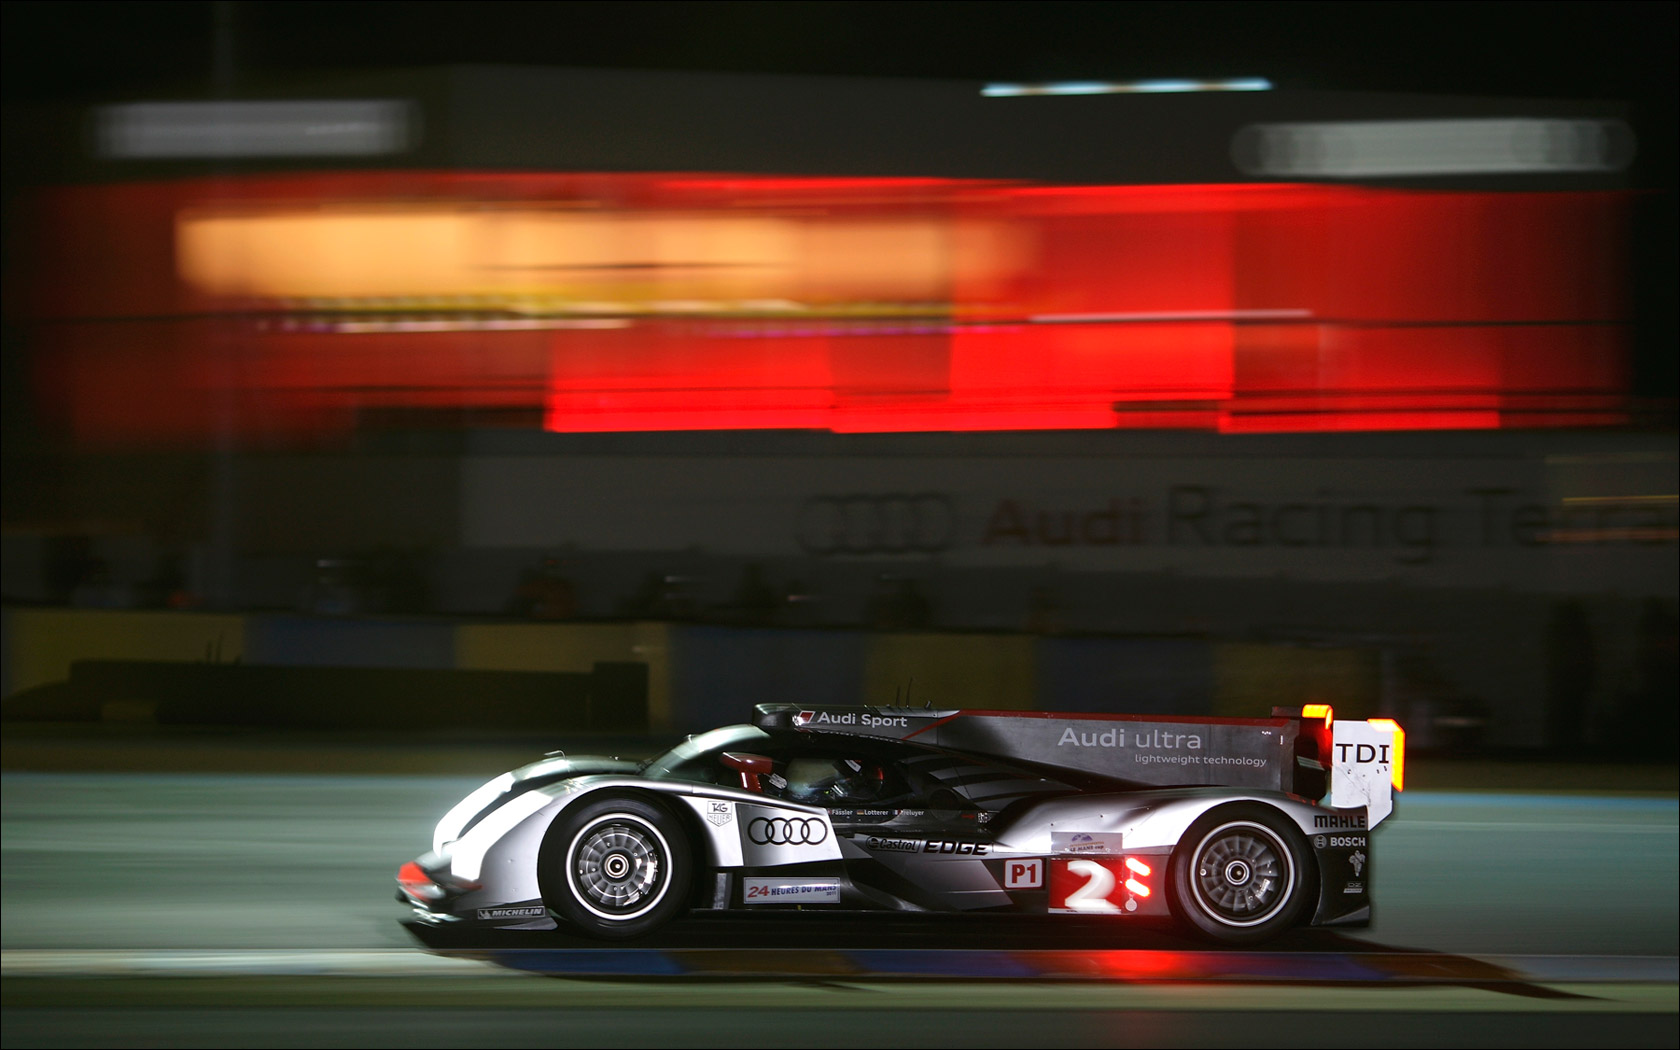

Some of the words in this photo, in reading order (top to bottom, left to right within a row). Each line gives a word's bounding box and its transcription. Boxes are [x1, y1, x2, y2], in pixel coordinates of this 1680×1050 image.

[979, 497, 1146, 547] Audi
[1165, 485, 1438, 563] Racing
[817, 711, 856, 725] Audi
[861, 713, 908, 728] Sport
[1057, 727, 1125, 748] Audi
[1135, 729, 1202, 749] ultra
[1135, 753, 1200, 766] lightweight
[1203, 755, 1267, 768] technology
[1335, 743, 1390, 764] TDI
[711, 802, 728, 813] TAG
[864, 808, 889, 816] Lotterer
[1314, 815, 1366, 829] MAHLE
[879, 838, 917, 851] Castrol
[922, 840, 991, 855] EDGE
[1330, 836, 1366, 847] BOSCH
[1011, 863, 1036, 884] P1
[747, 886, 770, 898] 24
[771, 886, 799, 896] HEURES
[1064, 859, 1121, 912] 2
[491, 908, 542, 917] MICHELIN
